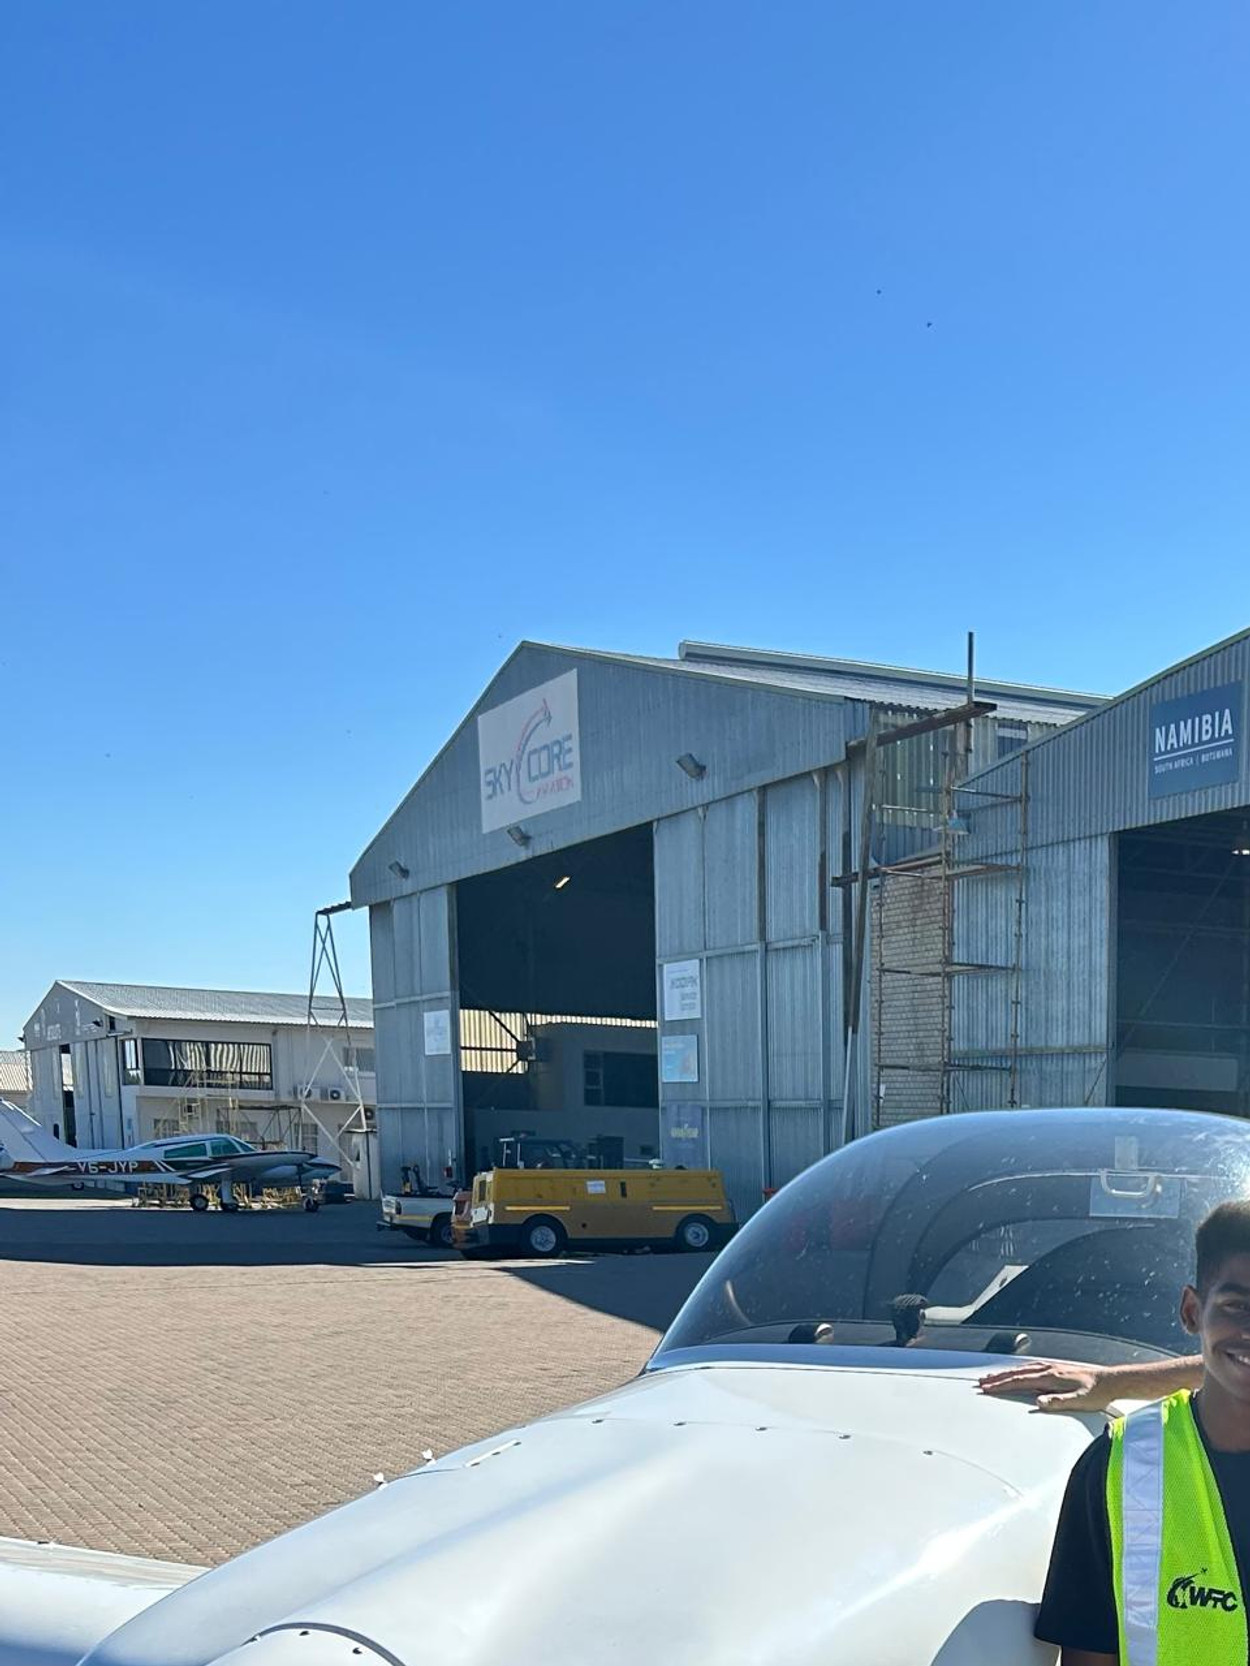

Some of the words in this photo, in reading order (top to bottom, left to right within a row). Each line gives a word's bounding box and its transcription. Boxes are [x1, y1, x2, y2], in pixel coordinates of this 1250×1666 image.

[1154, 708, 1233, 754] NAMIBIA
[484, 759, 514, 800] SKY
[527, 733, 574, 783] CORE
[1174, 756, 1194, 769] AFRICA
[1189, 1585, 1238, 1612] WFC
